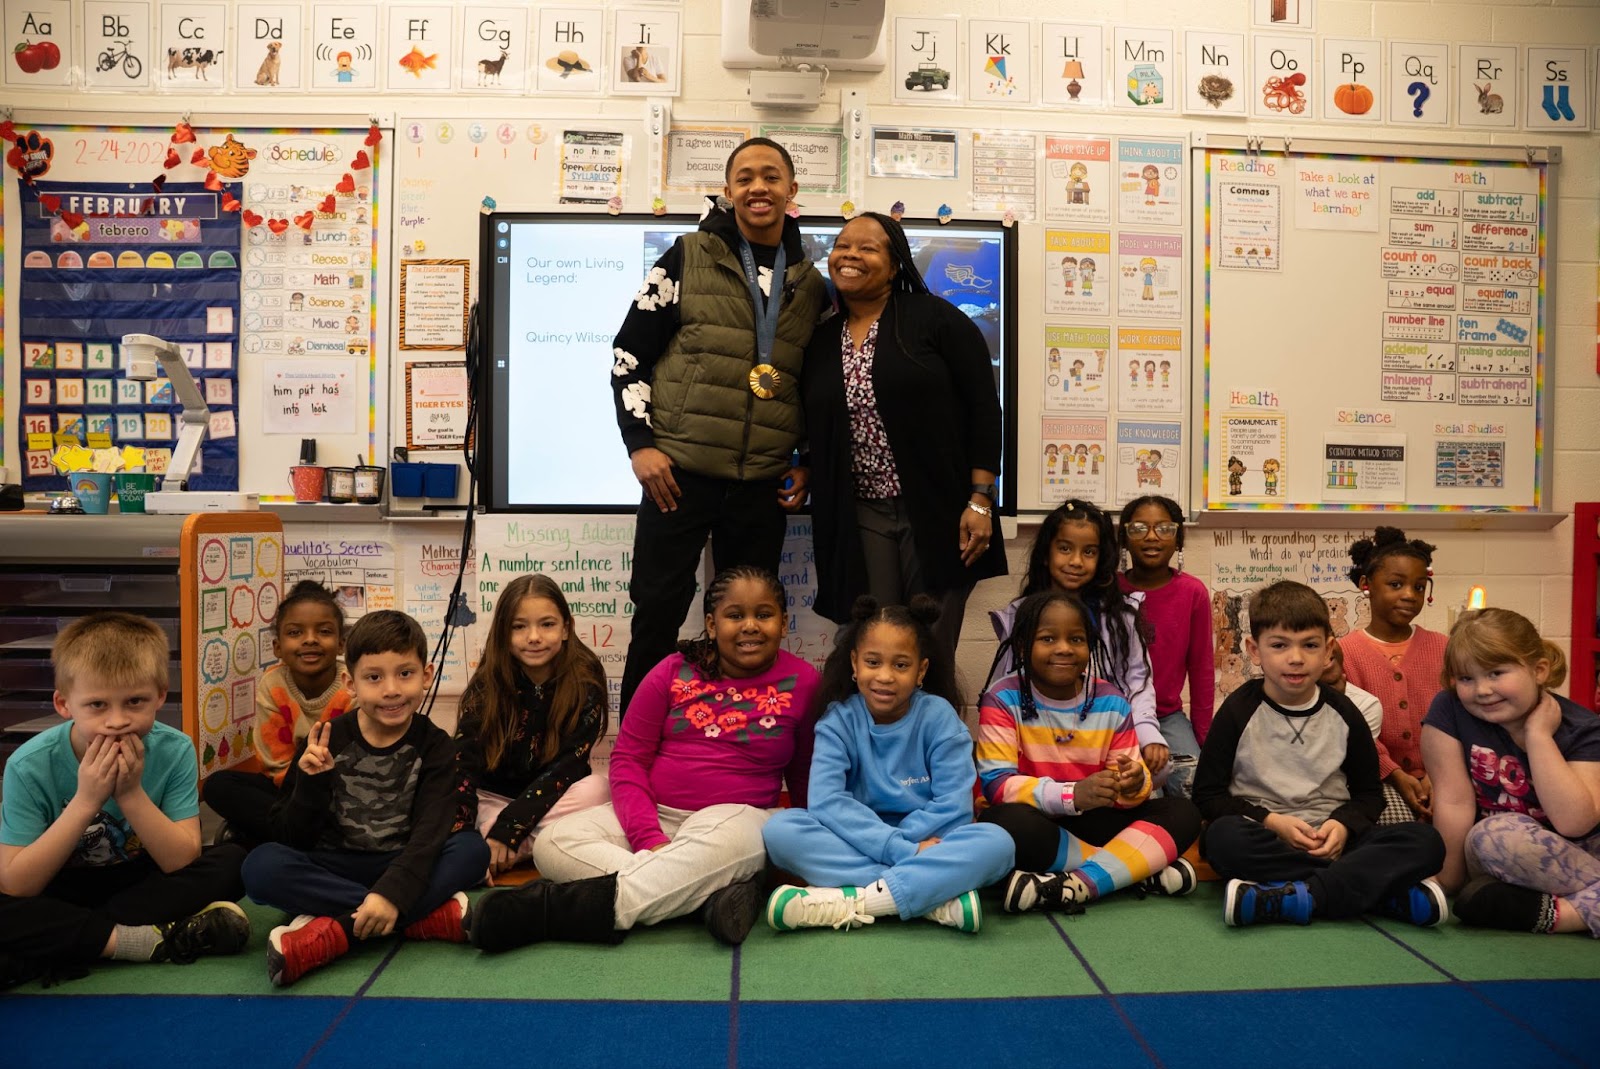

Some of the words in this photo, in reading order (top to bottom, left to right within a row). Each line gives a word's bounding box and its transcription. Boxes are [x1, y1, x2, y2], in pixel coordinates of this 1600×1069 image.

[22, 13, 52, 36] Aa
[102, 16, 130, 37] Bb
[178, 18, 204, 39] Cc
[255, 18, 283, 39] Dd
[331, 18, 355, 39] Ee
[408, 19, 429, 40] Ff
[478, 20, 511, 50] Gg
[556, 21, 584, 43] Hh
[639, 23, 651, 45] Ii
[910, 31, 936, 61] Jj
[985, 33, 1011, 55] Kk
[1124, 39, 1165, 62] Mm
[1202, 45, 1229, 66] Nn
[1270, 50, 1298, 70] Oo
[1341, 53, 1365, 82] Pp
[1405, 56, 1437, 84] Qq
[1477, 59, 1502, 80] Rr
[1546, 61, 1568, 82] Ss
[898, 132, 913, 140] Math
[676, 138, 684, 147] I
[685, 140, 712, 152] agree
[714, 138, 736, 149] with
[789, 142, 829, 155] disagree
[1049, 143, 1074, 154] NEVER
[1075, 144, 1095, 155] GIVE
[1096, 145, 1107, 156] UP
[270, 145, 335, 161] Schedule
[1120, 146, 1143, 157] THINK
[1146, 147, 1171, 158] ABOUT
[1172, 148, 1183, 159] IT
[561, 163, 584, 174] Open
[594, 164, 622, 173] Closed
[686, 161, 724, 172] because
[1219, 158, 1276, 177] Reading
[1299, 171, 1324, 183] Take
[1327, 175, 1335, 183] a
[1337, 172, 1360, 185] look
[1363, 173, 1375, 186] at
[1453, 170, 1487, 185] Math
[1230, 186, 1270, 196] Commas
[1305, 186, 1330, 198] what
[1334, 189, 1348, 200] we
[1351, 191, 1370, 200] are
[1416, 190, 1435, 201] add
[1477, 193, 1523, 206] subtract
[1313, 202, 1362, 217] learning!
[400, 216, 425, 229] Purple
[1414, 223, 1435, 232] sum
[99, 223, 150, 237] febrero
[315, 231, 347, 242] Lunch
[1471, 223, 1528, 237] difference
[1119, 237, 1141, 249] MODEL
[1142, 238, 1162, 250] WITH
[1163, 239, 1183, 251] MATH
[311, 254, 348, 265] Recess
[1383, 250, 1418, 262] count
[1421, 253, 1437, 263] on
[1463, 256, 1498, 268] count
[1502, 257, 1532, 269] back
[526, 257, 551, 268] Our
[555, 259, 582, 268] own
[585, 257, 625, 271] Living
[313, 274, 340, 286] Math
[526, 272, 579, 286] Legend:
[1426, 285, 1455, 298] equal
[1477, 289, 1518, 301] equation
[308, 296, 345, 308] Science
[312, 318, 340, 330] Music
[1388, 315, 1426, 326] number
[1428, 315, 1445, 326] line
[1458, 317, 1478, 329] ten
[525, 331, 573, 346] Quincy
[1086, 333, 1109, 344] TOOLS
[1120, 333, 1140, 344] WORK
[1142, 334, 1182, 346] CAREFULLY
[1458, 329, 1497, 342] frame
[306, 341, 346, 351] Dismissal
[1383, 343, 1429, 355] addend
[1459, 347, 1493, 358] missing
[1495, 347, 1530, 358] addend
[32, 348, 40, 361] 2
[65, 348, 74, 362] 3
[95, 349, 104, 362] 4
[186, 348, 194, 361] 7
[1383, 373, 1433, 386] minuend
[1460, 378, 1527, 391] subtrahend
[34, 384, 42, 398] 9
[62, 384, 78, 398] 10
[92, 384, 107, 398] 11
[121, 384, 137, 398] 12
[211, 384, 227, 398] 15
[273, 384, 292, 396] him
[298, 384, 316, 400] put
[322, 383, 340, 396] has
[414, 401, 439, 409] TIGER
[440, 400, 464, 408] EYES!
[1231, 390, 1280, 407] Health
[283, 402, 299, 415] into
[311, 402, 328, 414] look
[1228, 418, 1279, 426] COMMUNICATE
[1338, 410, 1392, 424] Science
[30, 420, 46, 433] 16
[121, 420, 137, 433] 19
[149, 419, 166, 432] 20
[212, 417, 231, 432] 22
[1435, 424, 1464, 434] Social
[1467, 424, 1505, 434] Studies
[1120, 428, 1133, 439] USE
[1134, 428, 1180, 440] KNOWLEDGE
[30, 455, 48, 470] 23
[125, 482, 136, 490] BE
[507, 521, 570, 552] Missing
[1213, 531, 1233, 547] Will
[1241, 531, 1257, 545] the
[1261, 531, 1316, 554] groundhog
[1322, 533, 1339, 544] see
[1343, 531, 1356, 544] its
[339, 541, 384, 554] Secret
[422, 545, 459, 560] Mother
[481, 552, 492, 572] A
[499, 552, 546, 572] number
[550, 550, 613, 572] sentence
[1249, 547, 1273, 561] What
[1280, 548, 1292, 560] do
[1299, 550, 1312, 563] you
[302, 556, 359, 569] Vocabulary
[1235, 563, 1247, 573] the
[1248, 564, 1283, 577] groundhog
[1284, 564, 1298, 573] will
[479, 580, 499, 593] one
[561, 576, 586, 593] and
[591, 576, 611, 593] the
[481, 595, 492, 612] to
[592, 624, 615, 648] 12
